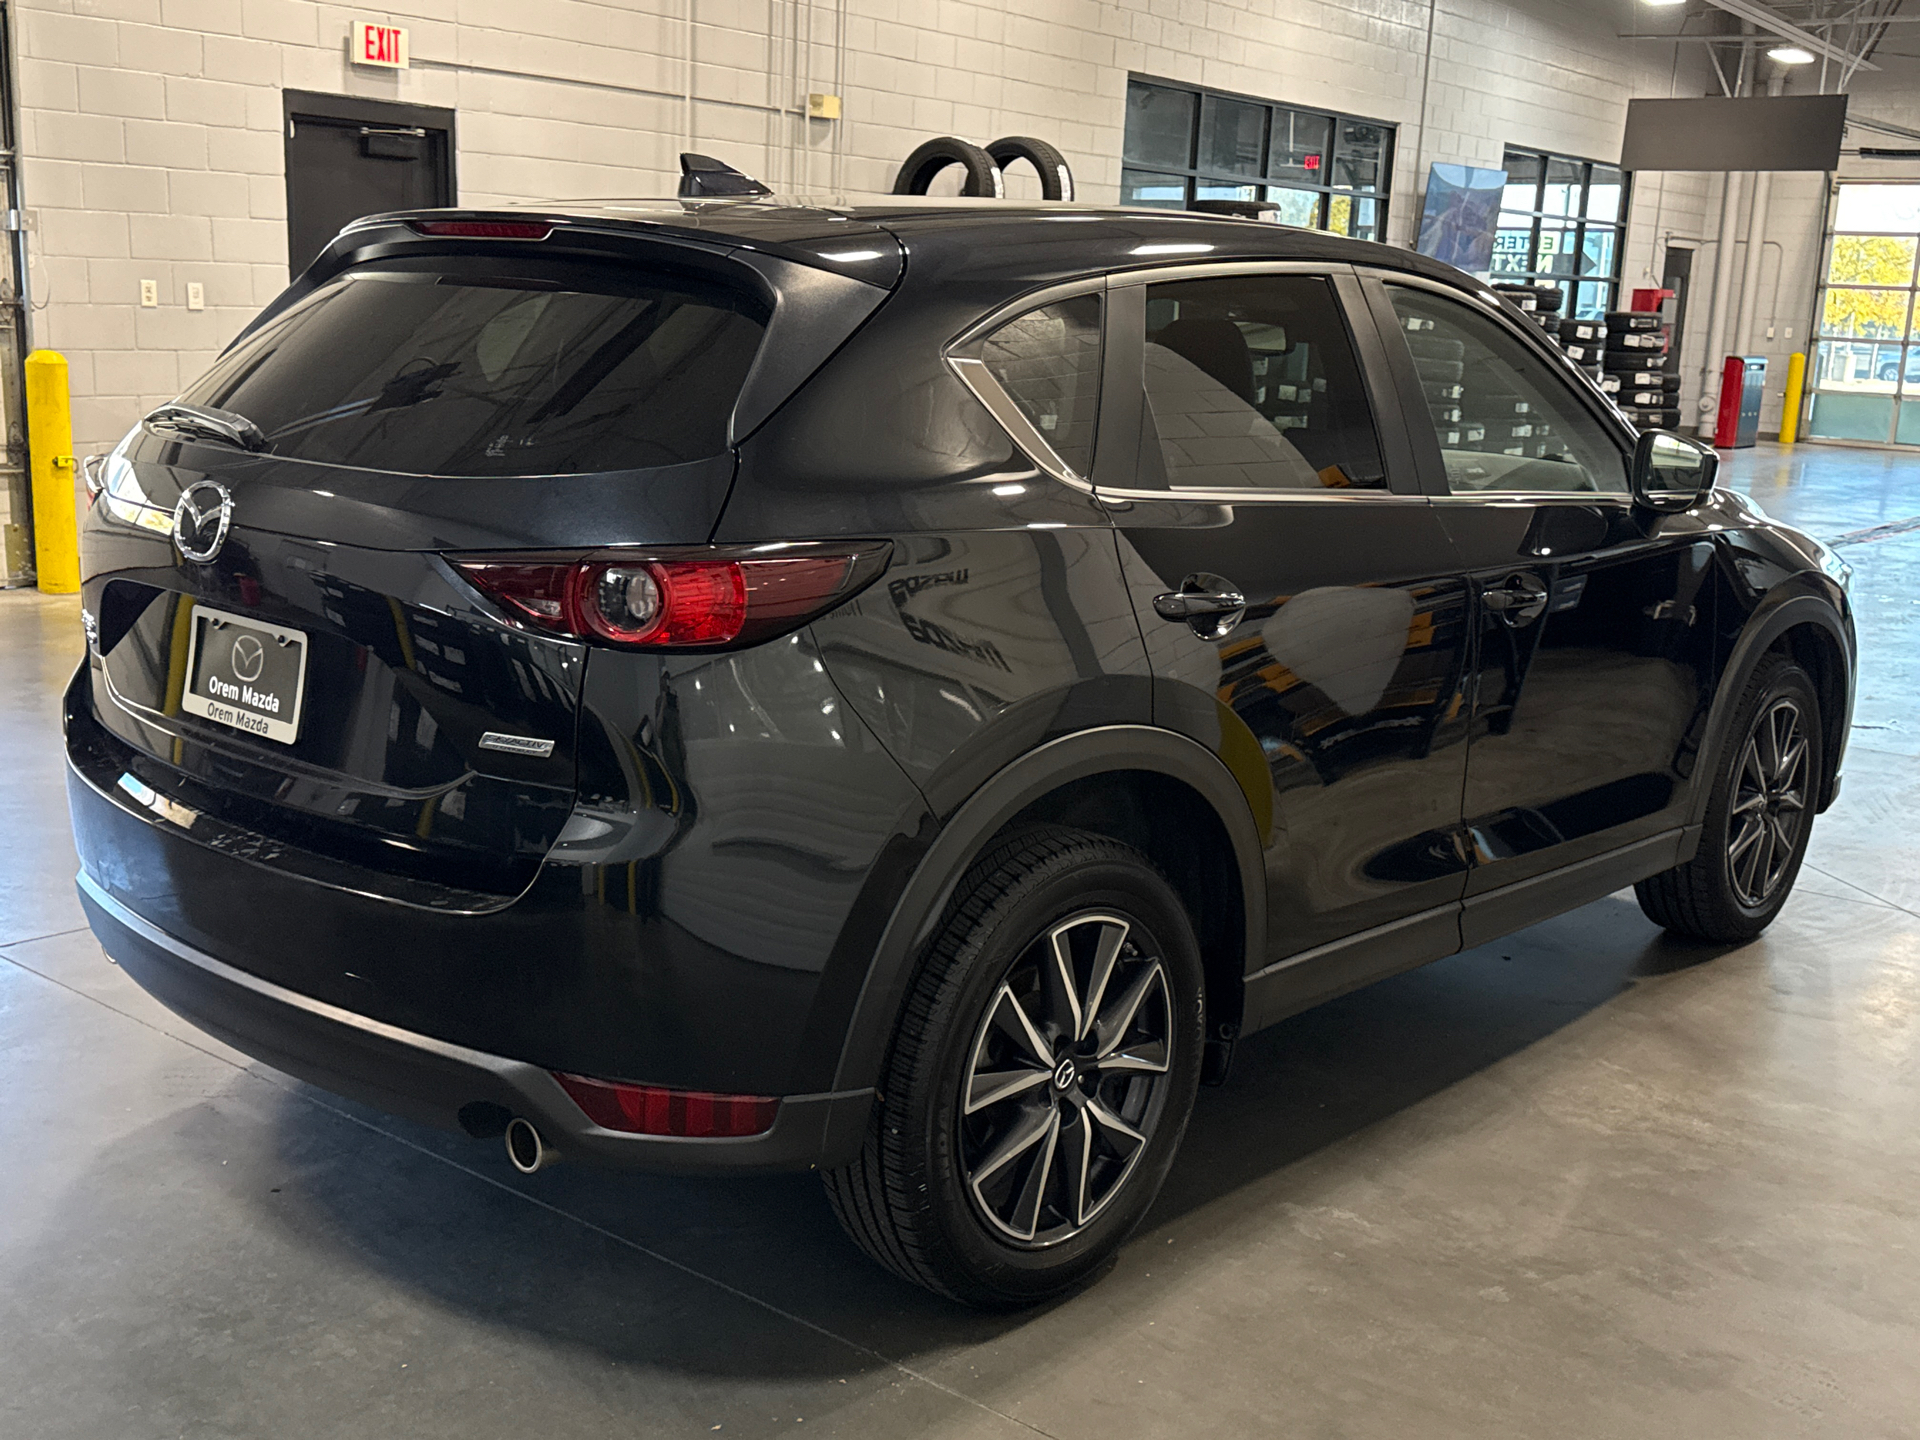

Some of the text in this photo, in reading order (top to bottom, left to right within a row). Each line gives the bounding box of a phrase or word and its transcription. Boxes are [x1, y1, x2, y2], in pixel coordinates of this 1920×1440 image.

[365, 25, 401, 63] EXIT
[209, 675, 280, 713] Orem Mazda
[207, 702, 269, 734] Orem Mazda
